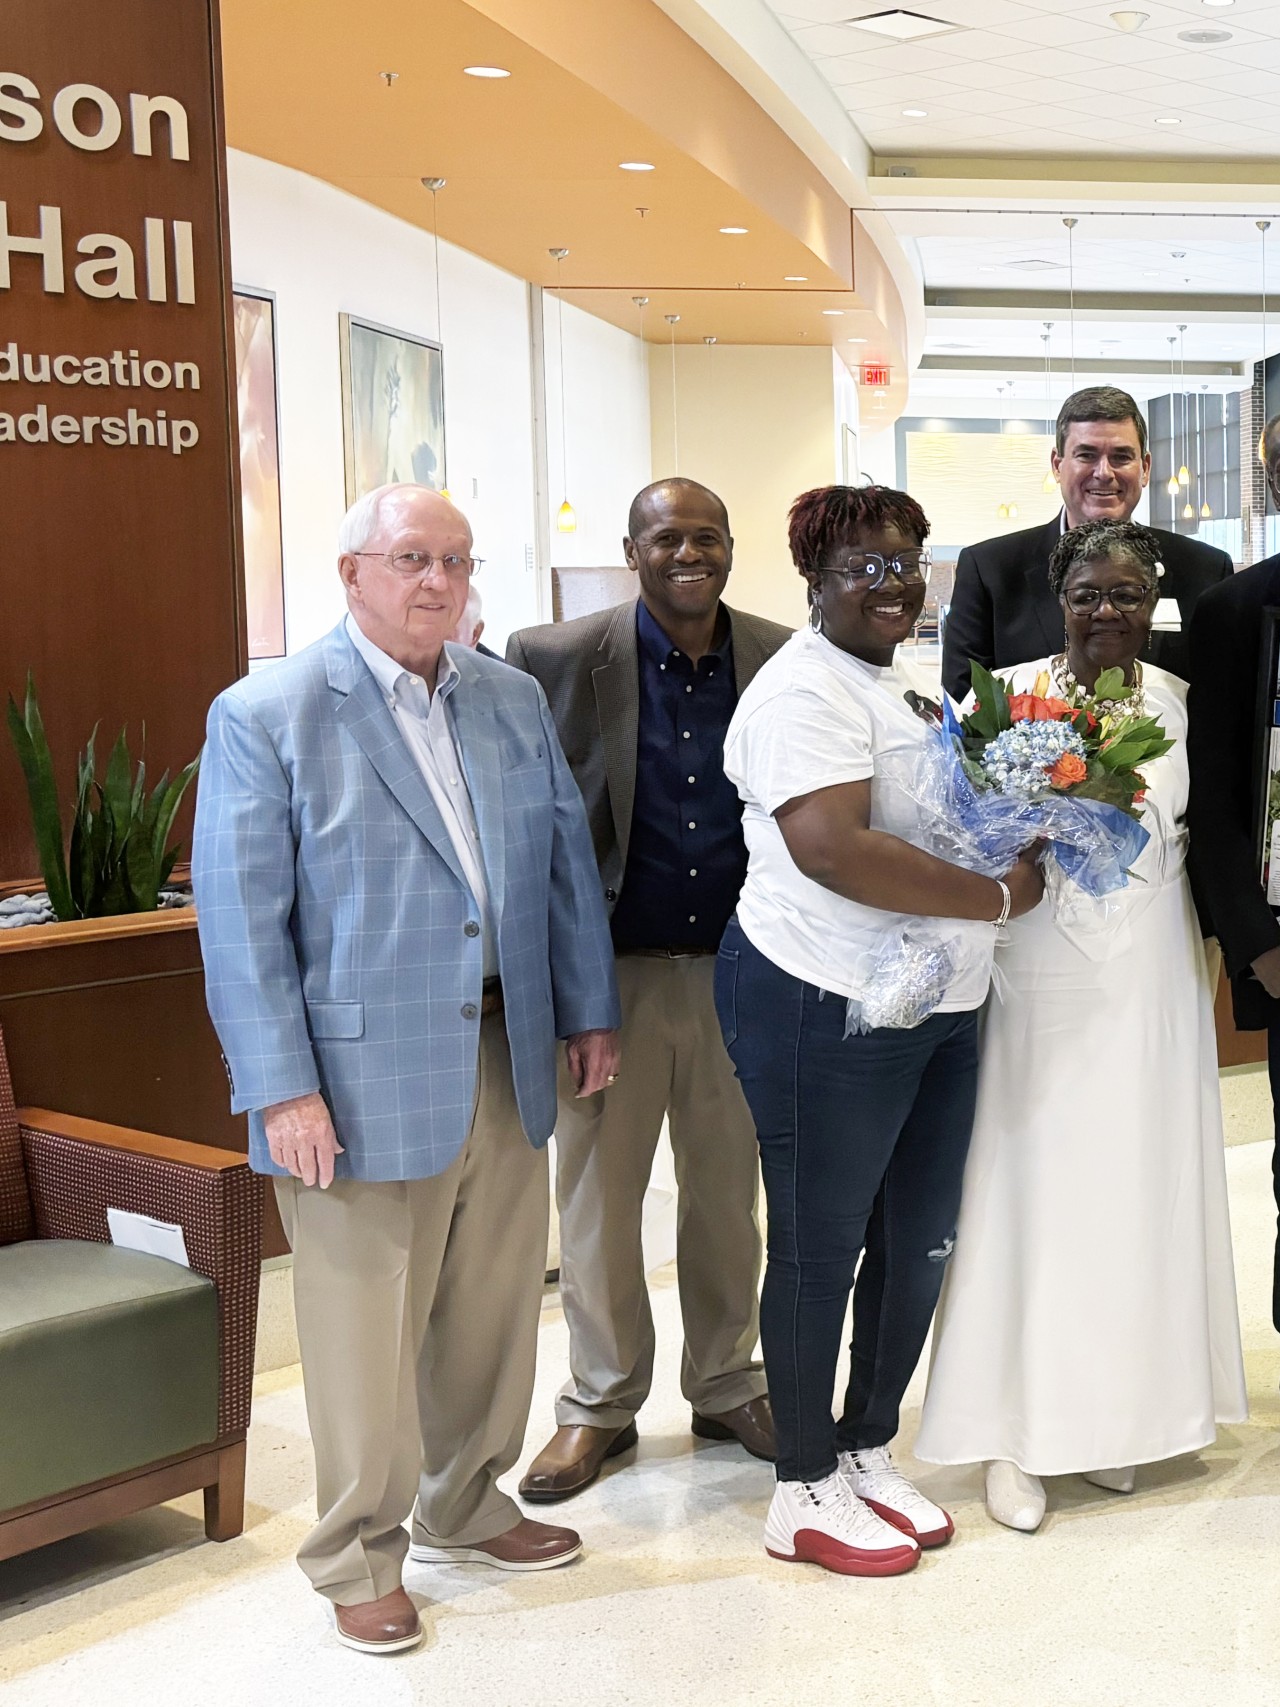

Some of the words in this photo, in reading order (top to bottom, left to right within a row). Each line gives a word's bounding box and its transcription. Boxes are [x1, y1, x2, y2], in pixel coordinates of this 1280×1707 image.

[0, 71, 191, 162] son
[0, 201, 196, 305] Hall
[0, 342, 201, 390] ducation
[864, 368, 888, 385] EXIT
[0, 403, 200, 455] adership
